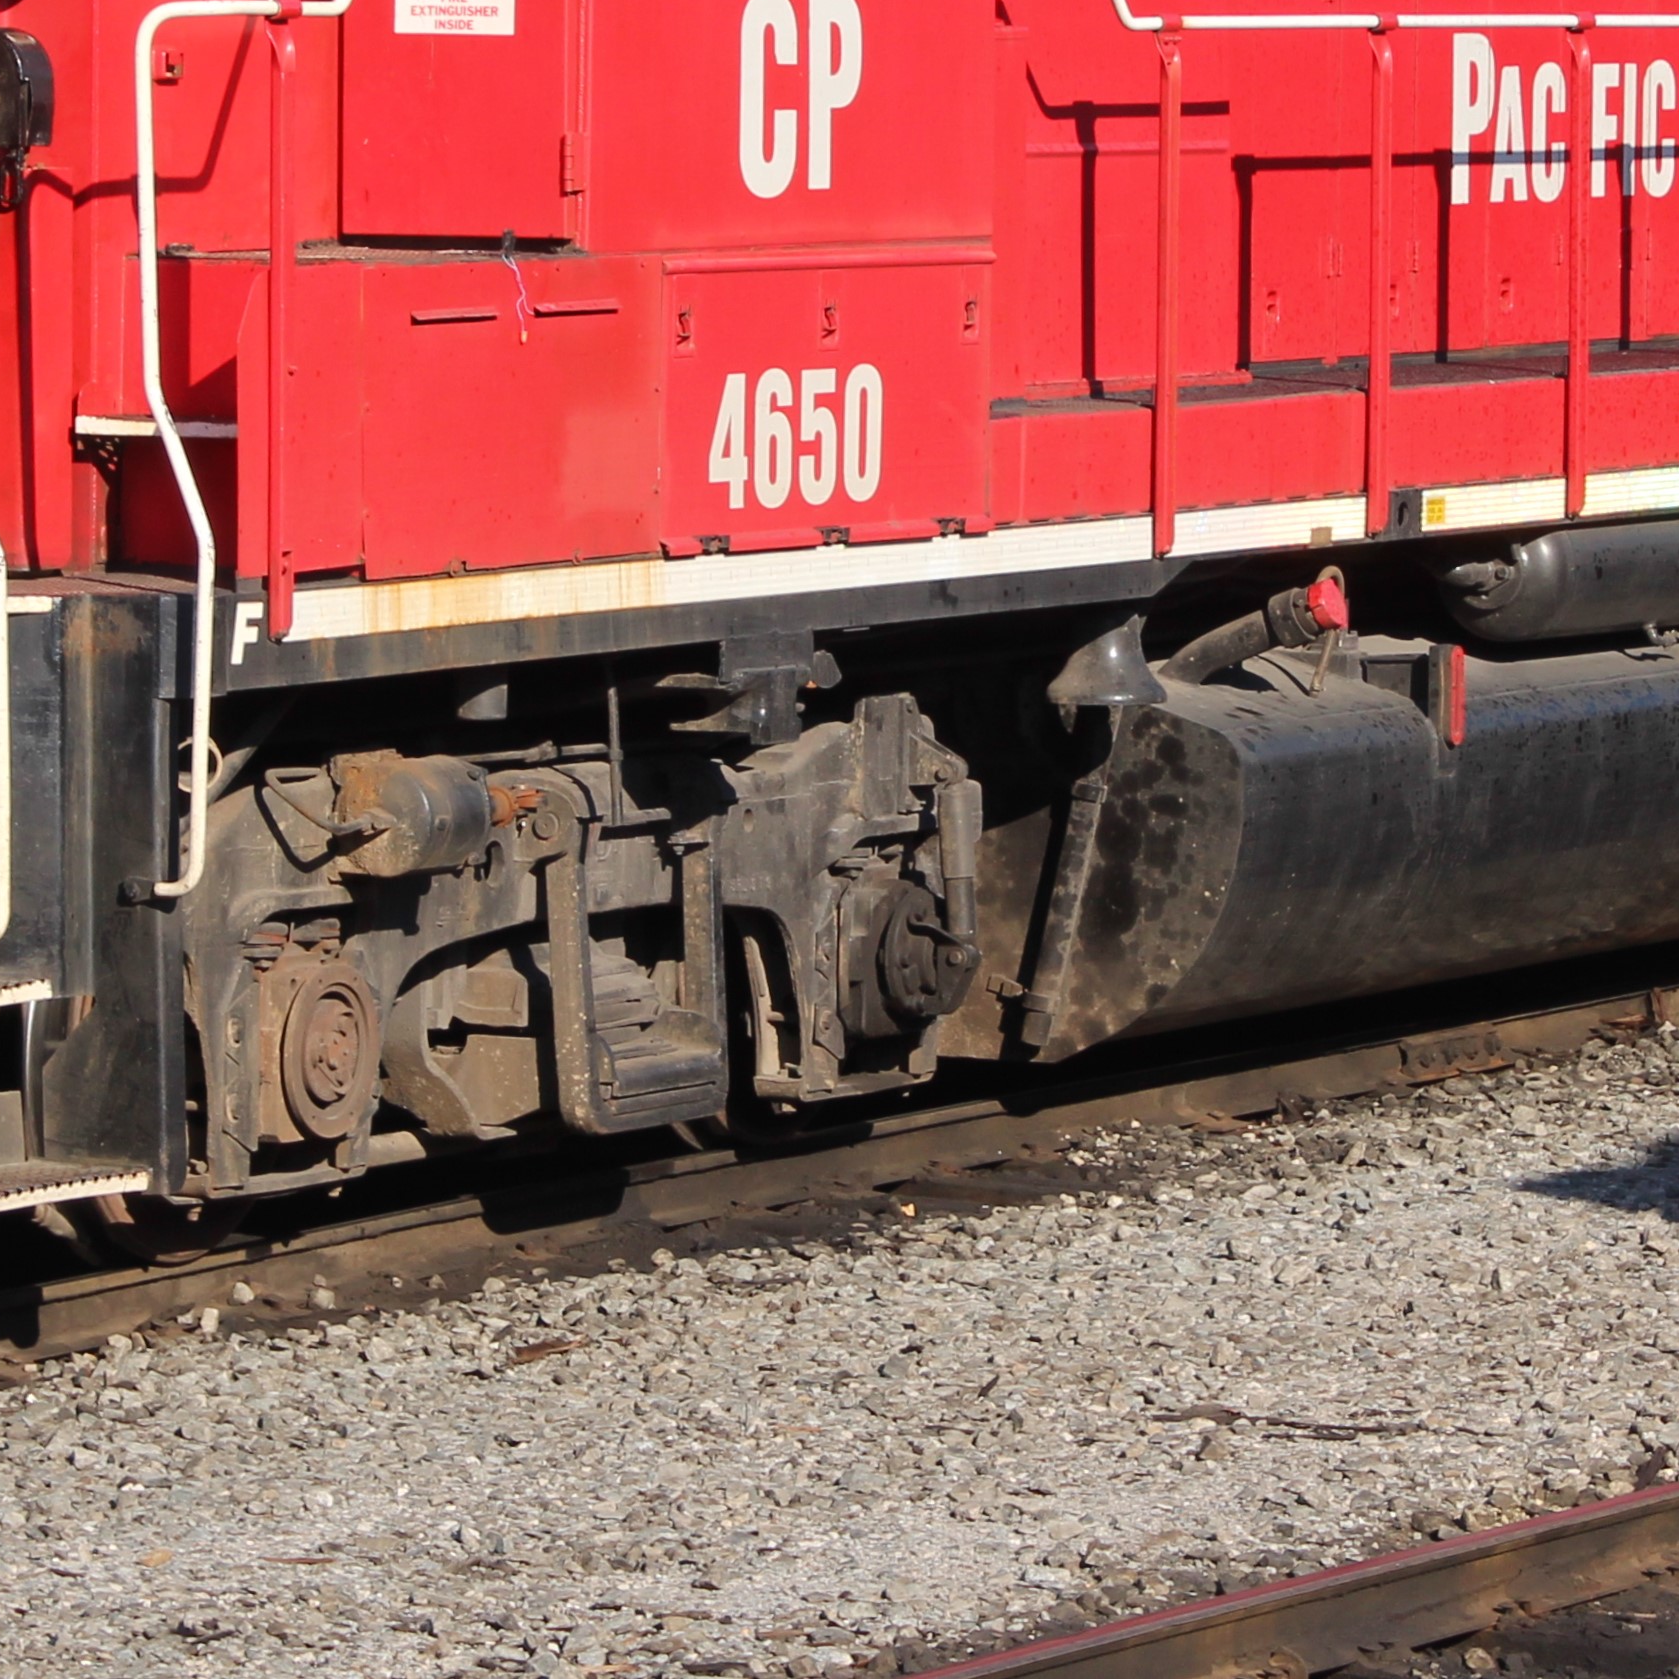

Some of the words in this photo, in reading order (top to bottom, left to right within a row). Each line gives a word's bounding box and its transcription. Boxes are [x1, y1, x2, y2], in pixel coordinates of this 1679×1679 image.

[409, 4, 500, 18] EXTINGUISHER
[433, 19, 475, 31] INSIDE
[1449, 32, 1677, 206] PACFIC
[707, 363, 883, 511] 4650
[230, 601, 264, 665] F
